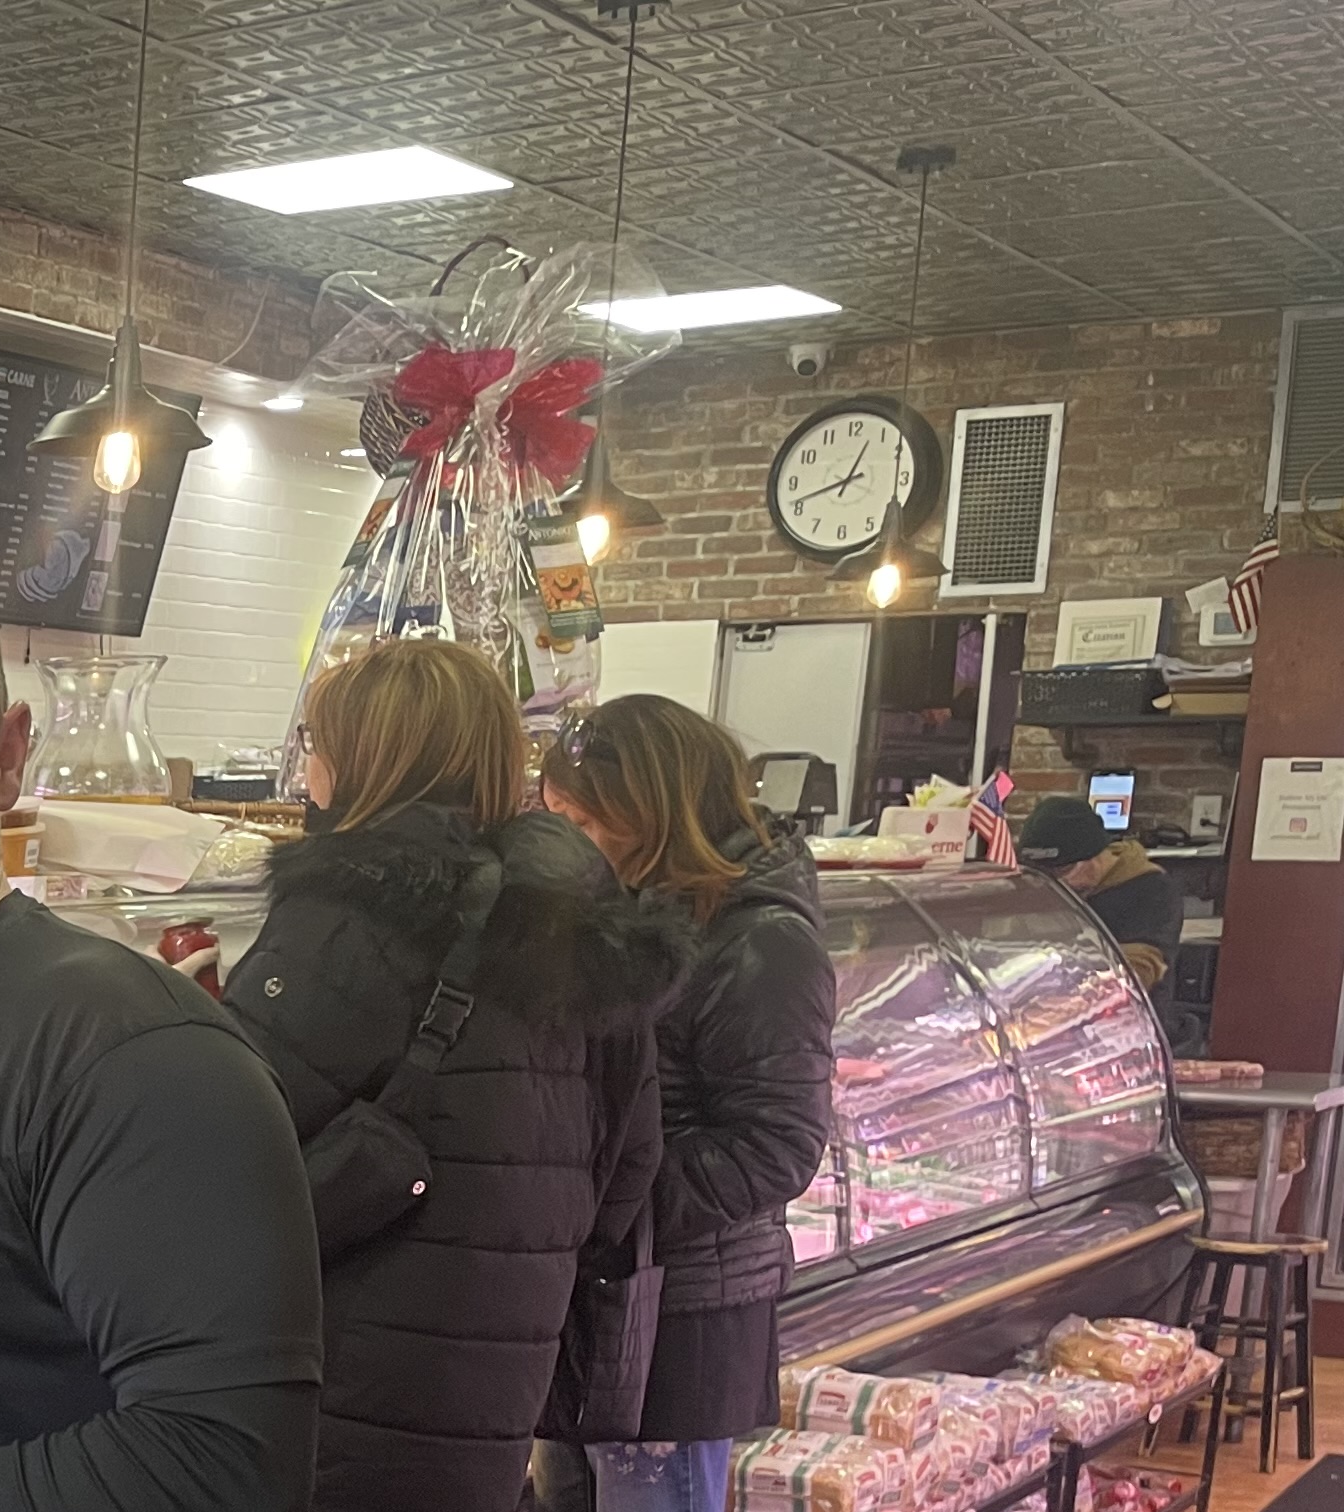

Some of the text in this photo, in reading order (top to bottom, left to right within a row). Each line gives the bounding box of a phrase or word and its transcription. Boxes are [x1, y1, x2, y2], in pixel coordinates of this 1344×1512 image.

[848, 421, 863, 437] 12
[881, 428, 886, 443] 1
[823, 430, 835, 445] 11
[801, 449, 816, 465] 10
[789, 476, 798, 491] 9
[899, 471, 909, 486] 3
[794, 500, 804, 516] 8
[812, 518, 821, 533] 7
[865, 517, 874, 532] 5
[837, 525, 847, 540] 6
